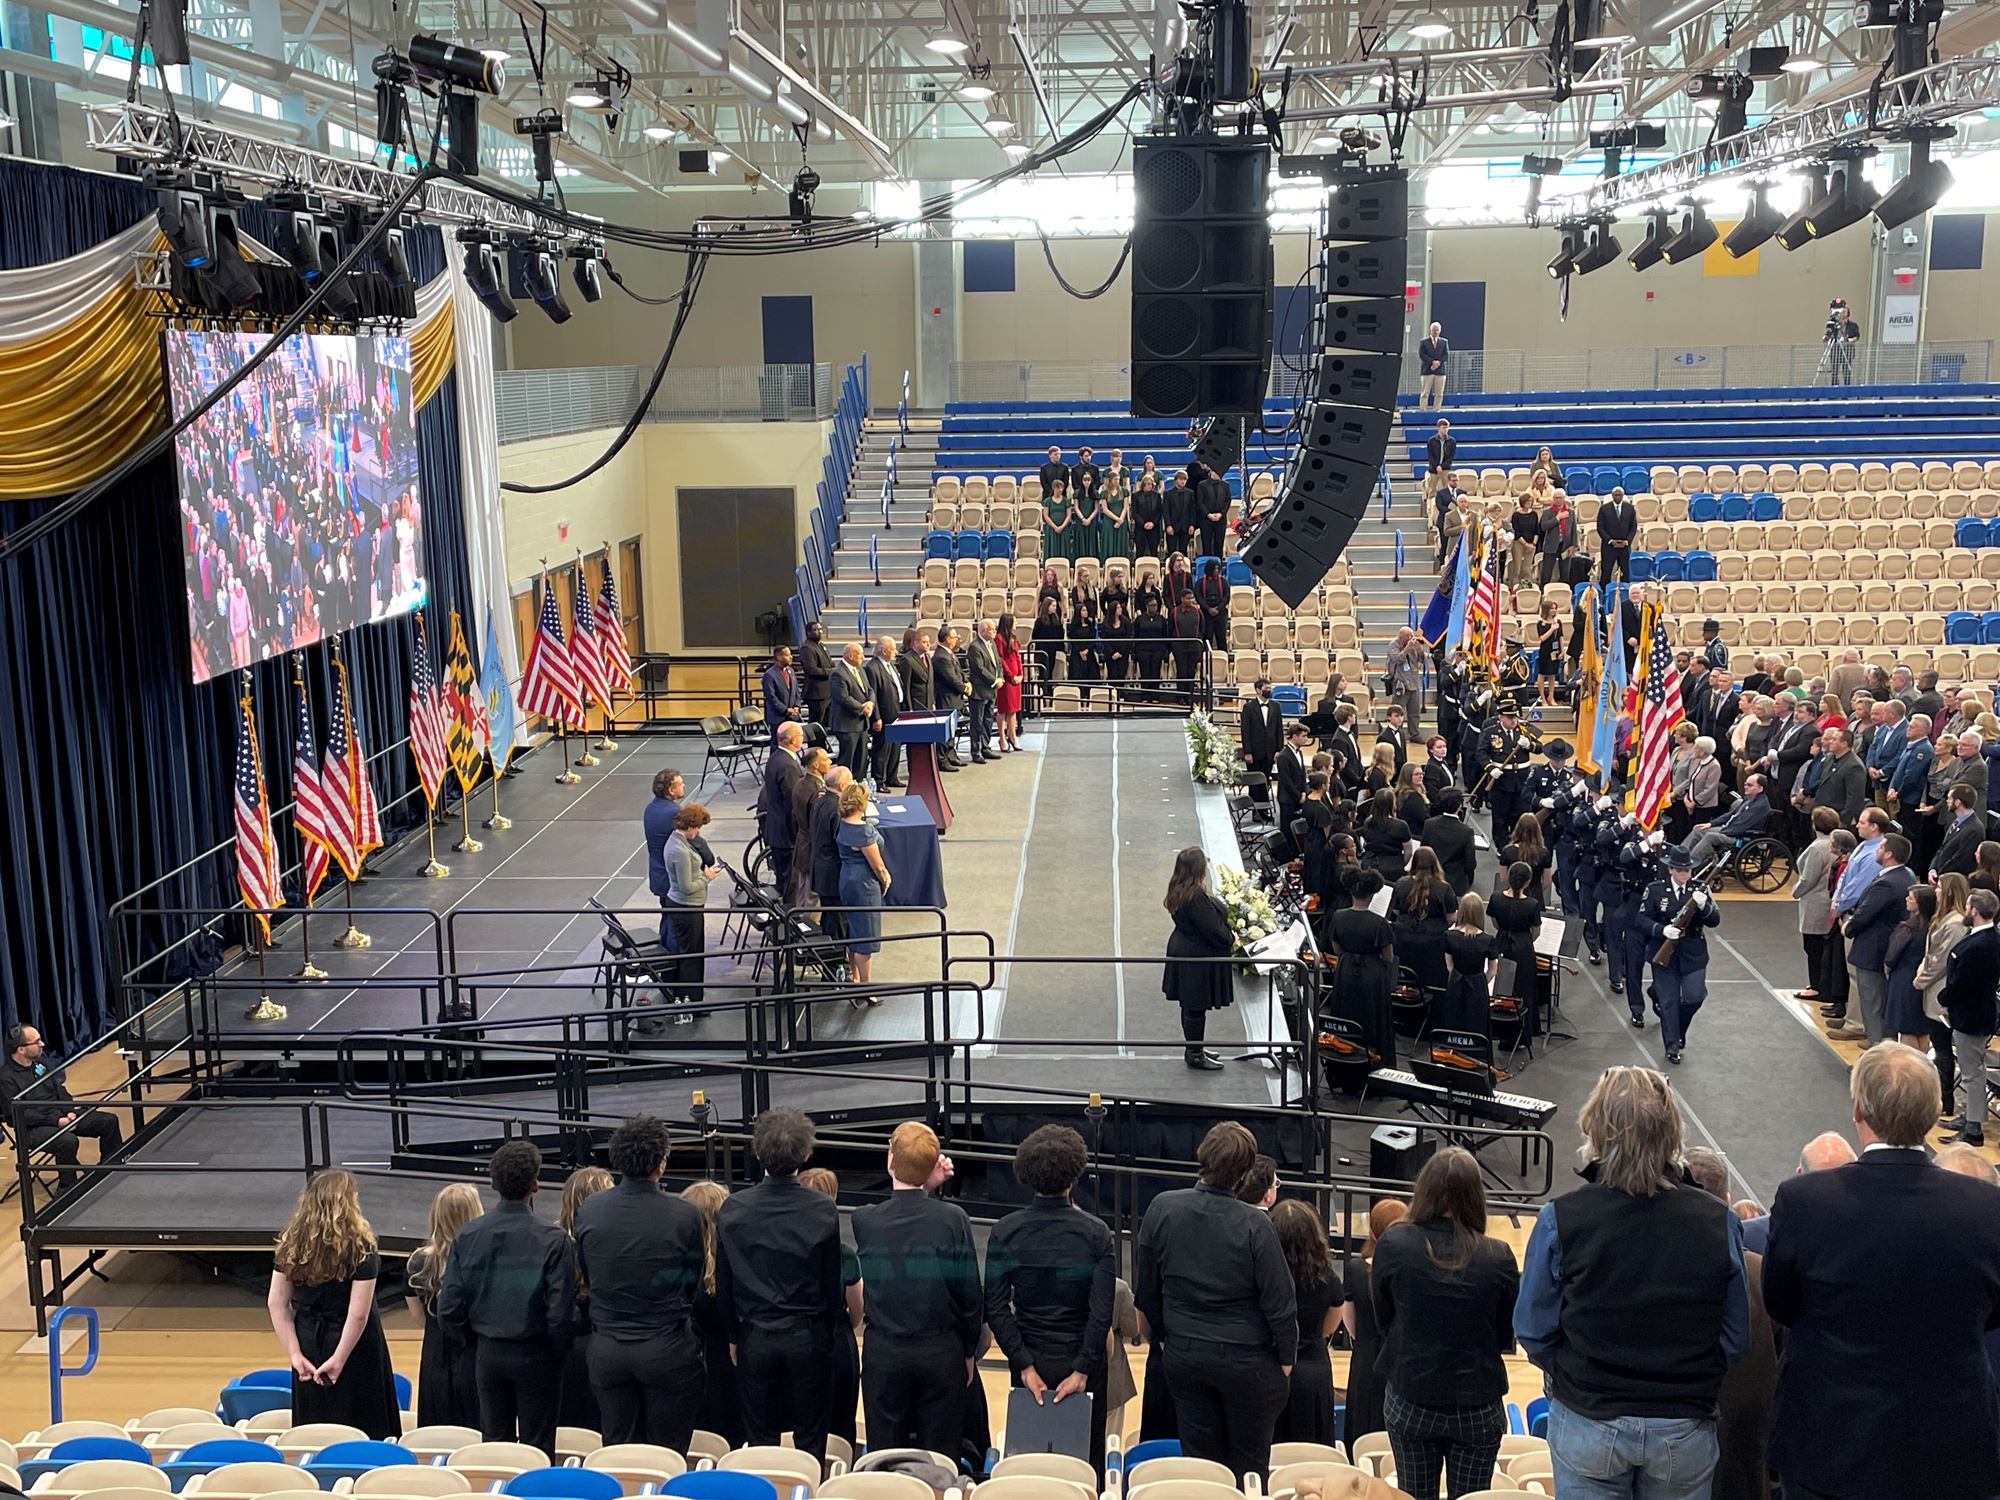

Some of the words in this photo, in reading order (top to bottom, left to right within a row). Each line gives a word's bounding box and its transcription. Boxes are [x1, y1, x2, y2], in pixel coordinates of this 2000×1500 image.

[1889, 315, 1914, 324] ARENA
[1686, 352, 1694, 365] B
[1324, 1021, 1348, 1032] ARENA
[1447, 1036, 1475, 1046] ARENA
